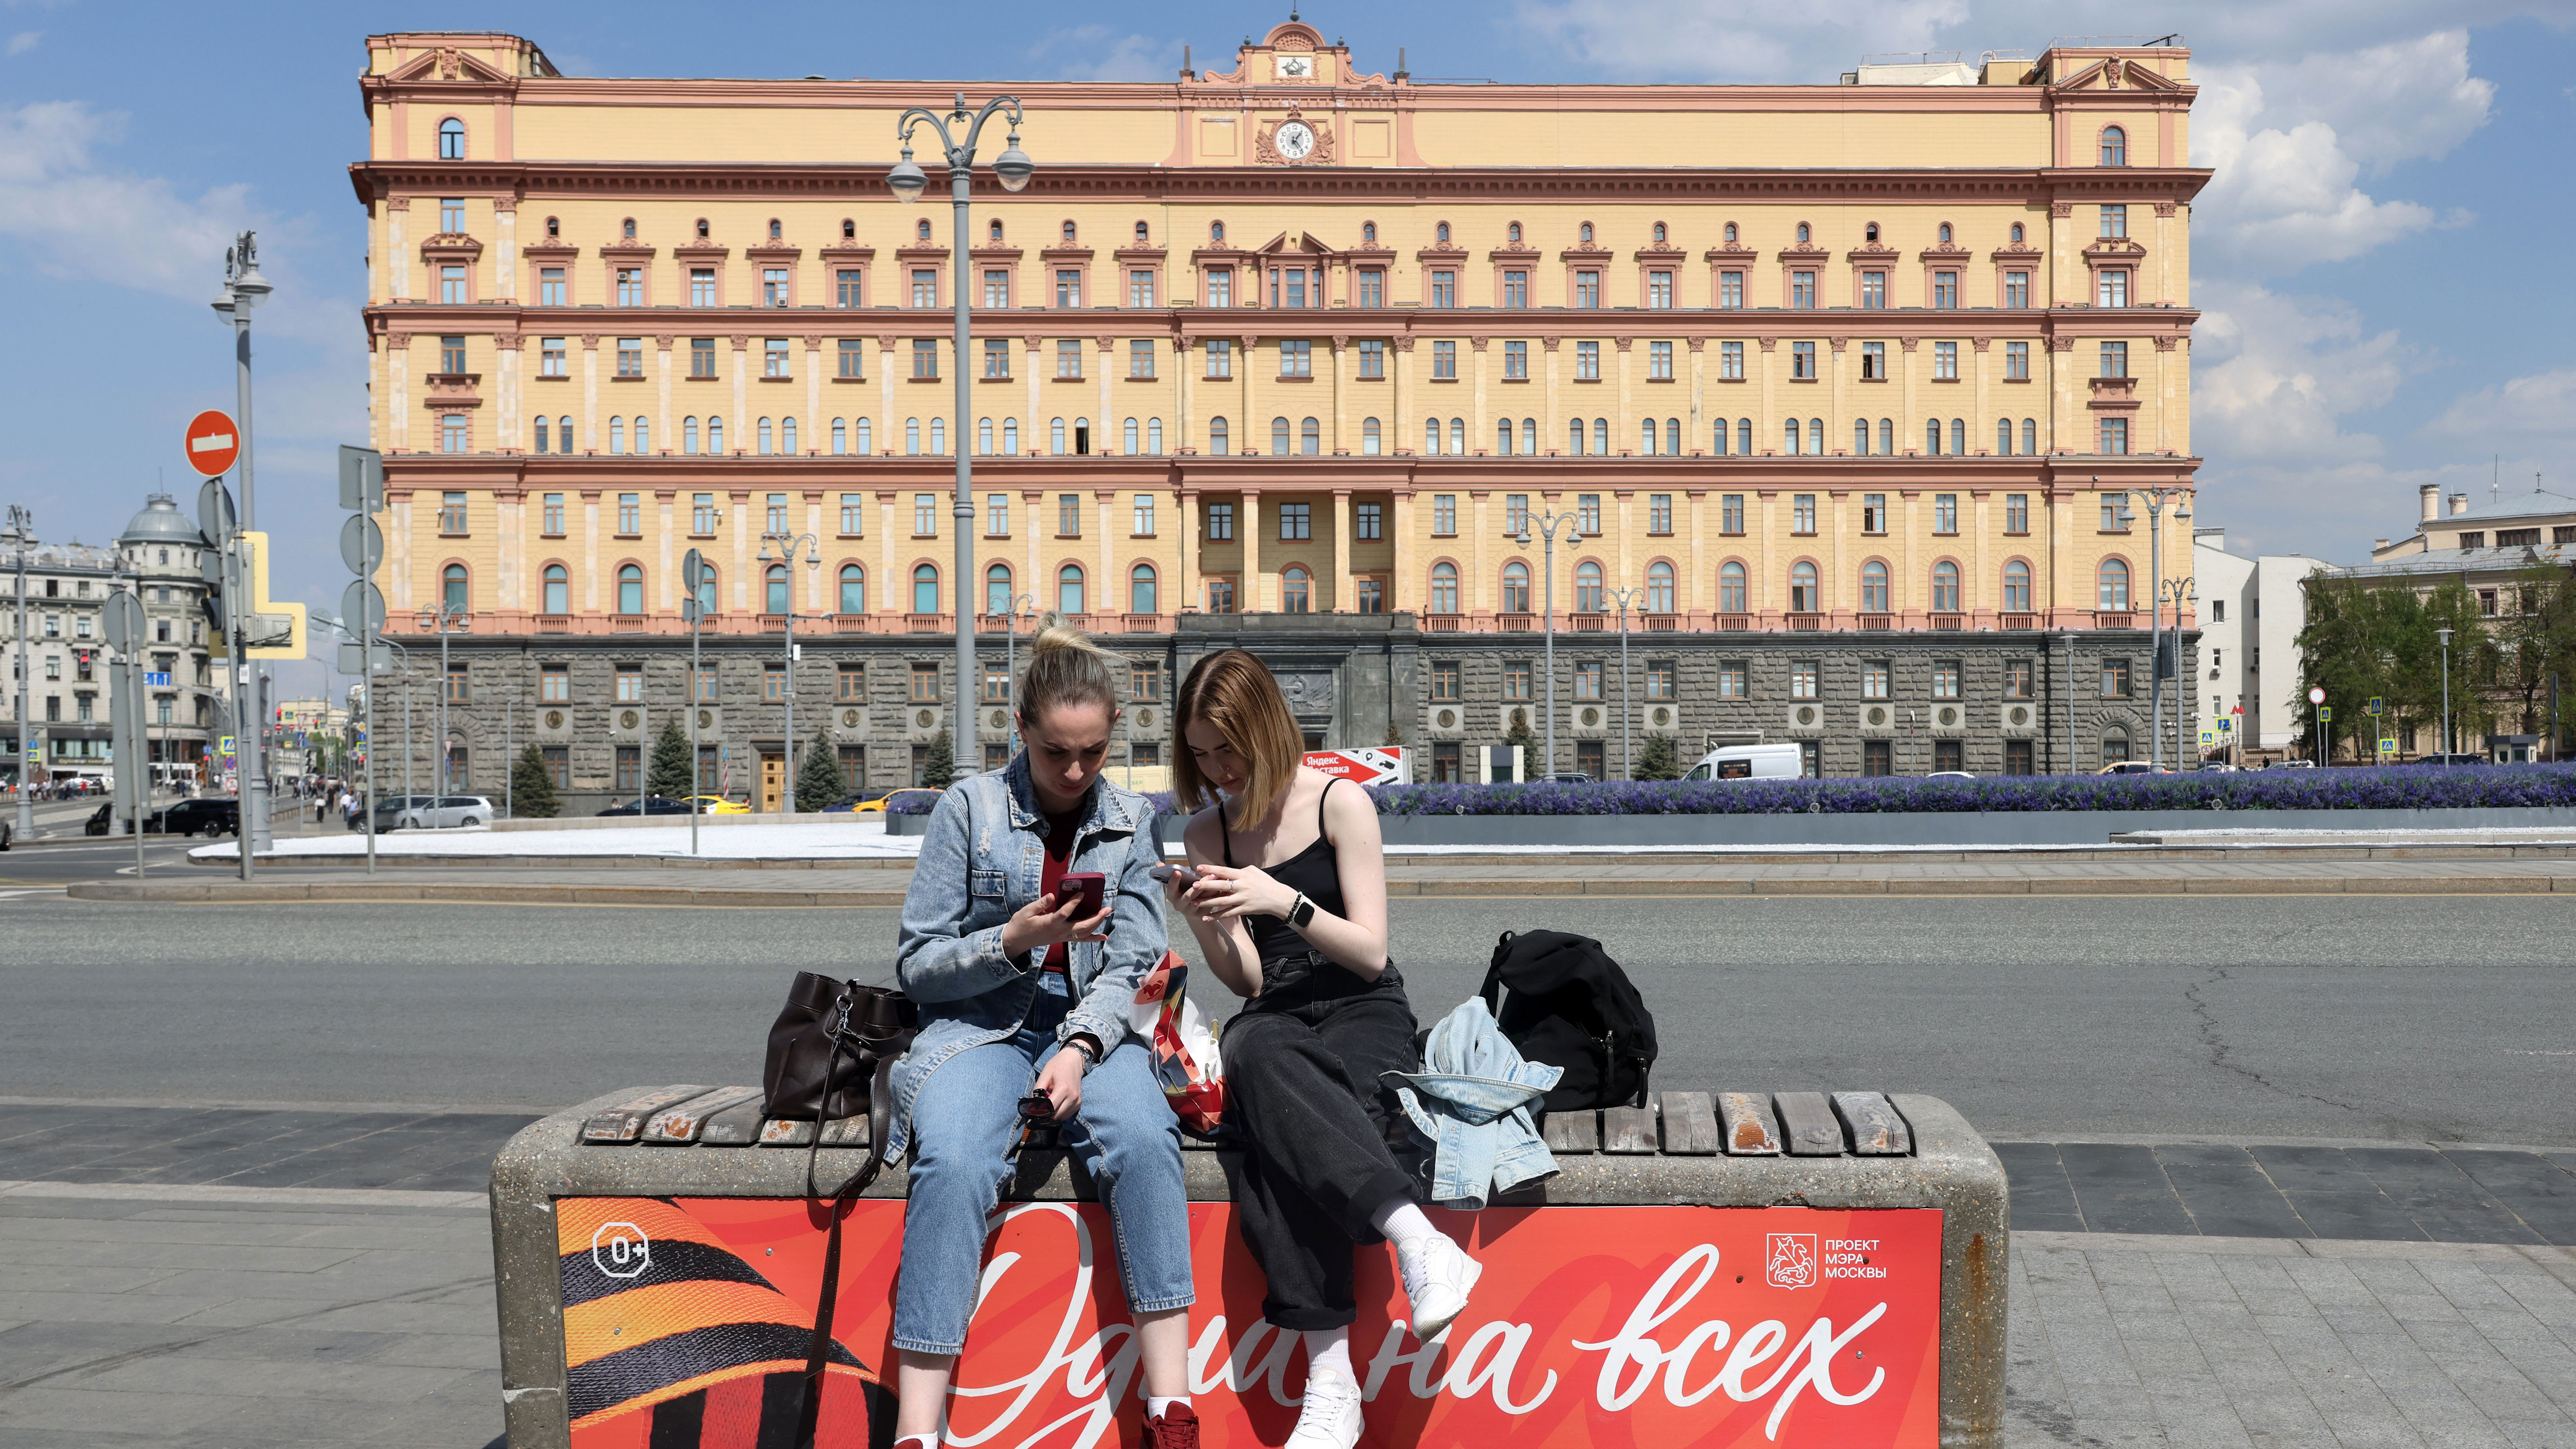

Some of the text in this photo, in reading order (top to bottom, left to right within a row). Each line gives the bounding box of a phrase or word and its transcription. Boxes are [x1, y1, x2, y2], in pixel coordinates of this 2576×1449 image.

[1307, 756, 1339, 766] Яндекс
[611, 1236, 646, 1263] 0+
[1825, 1239, 1880, 1250] ПРОЕКТ
[1825, 1253, 1865, 1264] МЭРА
[1825, 1267, 1886, 1278] МОСКВЫ
[1361, 1319, 1557, 1415] на
[1572, 1243, 1888, 1442] всех
